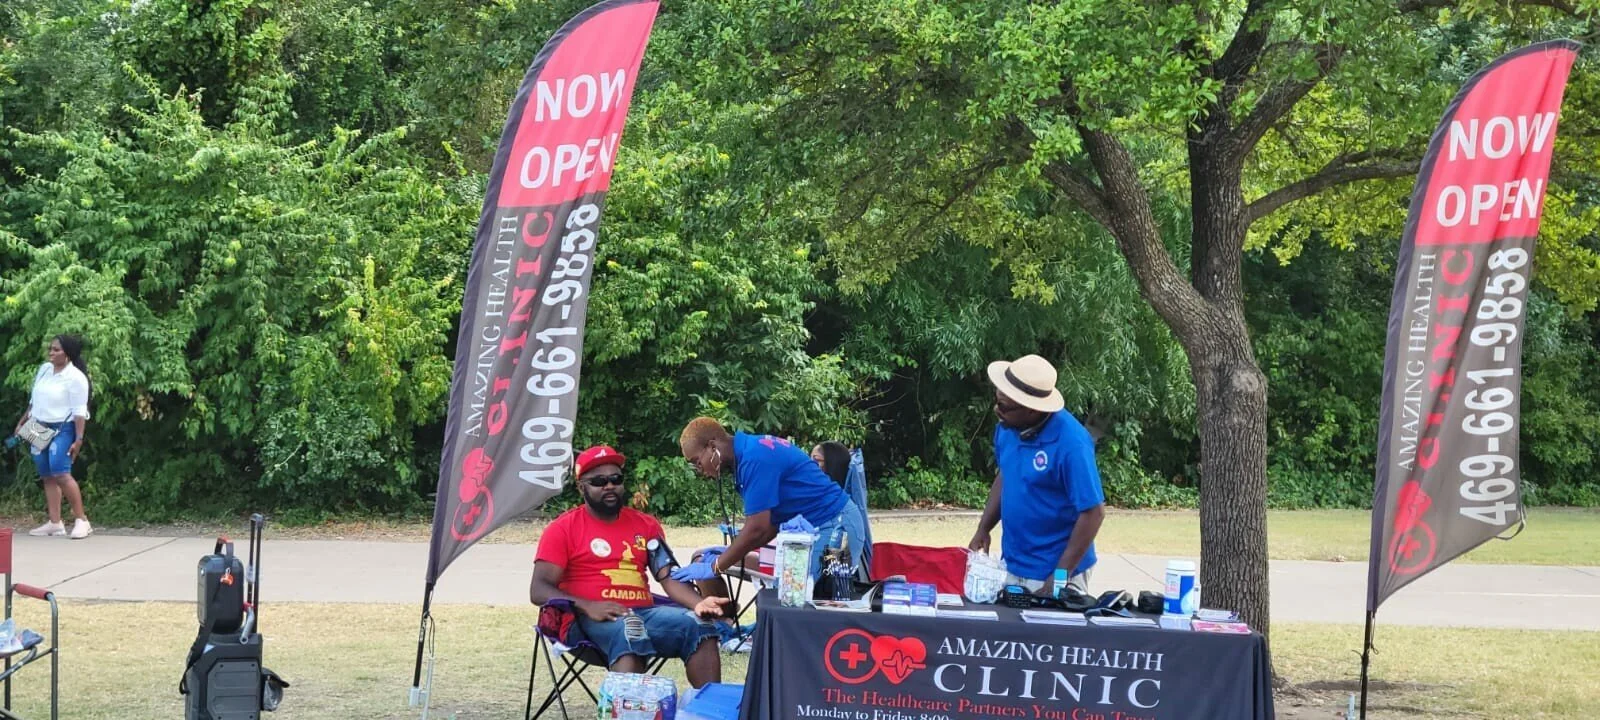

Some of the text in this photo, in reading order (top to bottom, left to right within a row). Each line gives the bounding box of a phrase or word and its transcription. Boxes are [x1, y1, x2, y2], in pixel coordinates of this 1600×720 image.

[534, 68, 626, 122] NOW
[519, 133, 618, 189] OPEN
[1448, 112, 1556, 161] NOW
[1435, 178, 1543, 227] OPEN
[465, 215, 518, 438] AMAZING HEALTH
[519, 203, 599, 490] 469-661-9858
[1398, 253, 1437, 472] AMAZING HEALTH
[1459, 247, 1528, 526] 469-661-9858
[937, 637, 1165, 671] AMAZING HEALTH
[821, 688, 856, 704] The
[862, 690, 952, 711] Healthcare
[958, 698, 1026, 717] Partners
[1031, 704, 1066, 720] You
[1071, 707, 1104, 720] Can
[933, 663, 1161, 709] CLINIC
[797, 704, 852, 720] Monday
[855, 710, 869, 720] to
[873, 709, 916, 720] Friday
